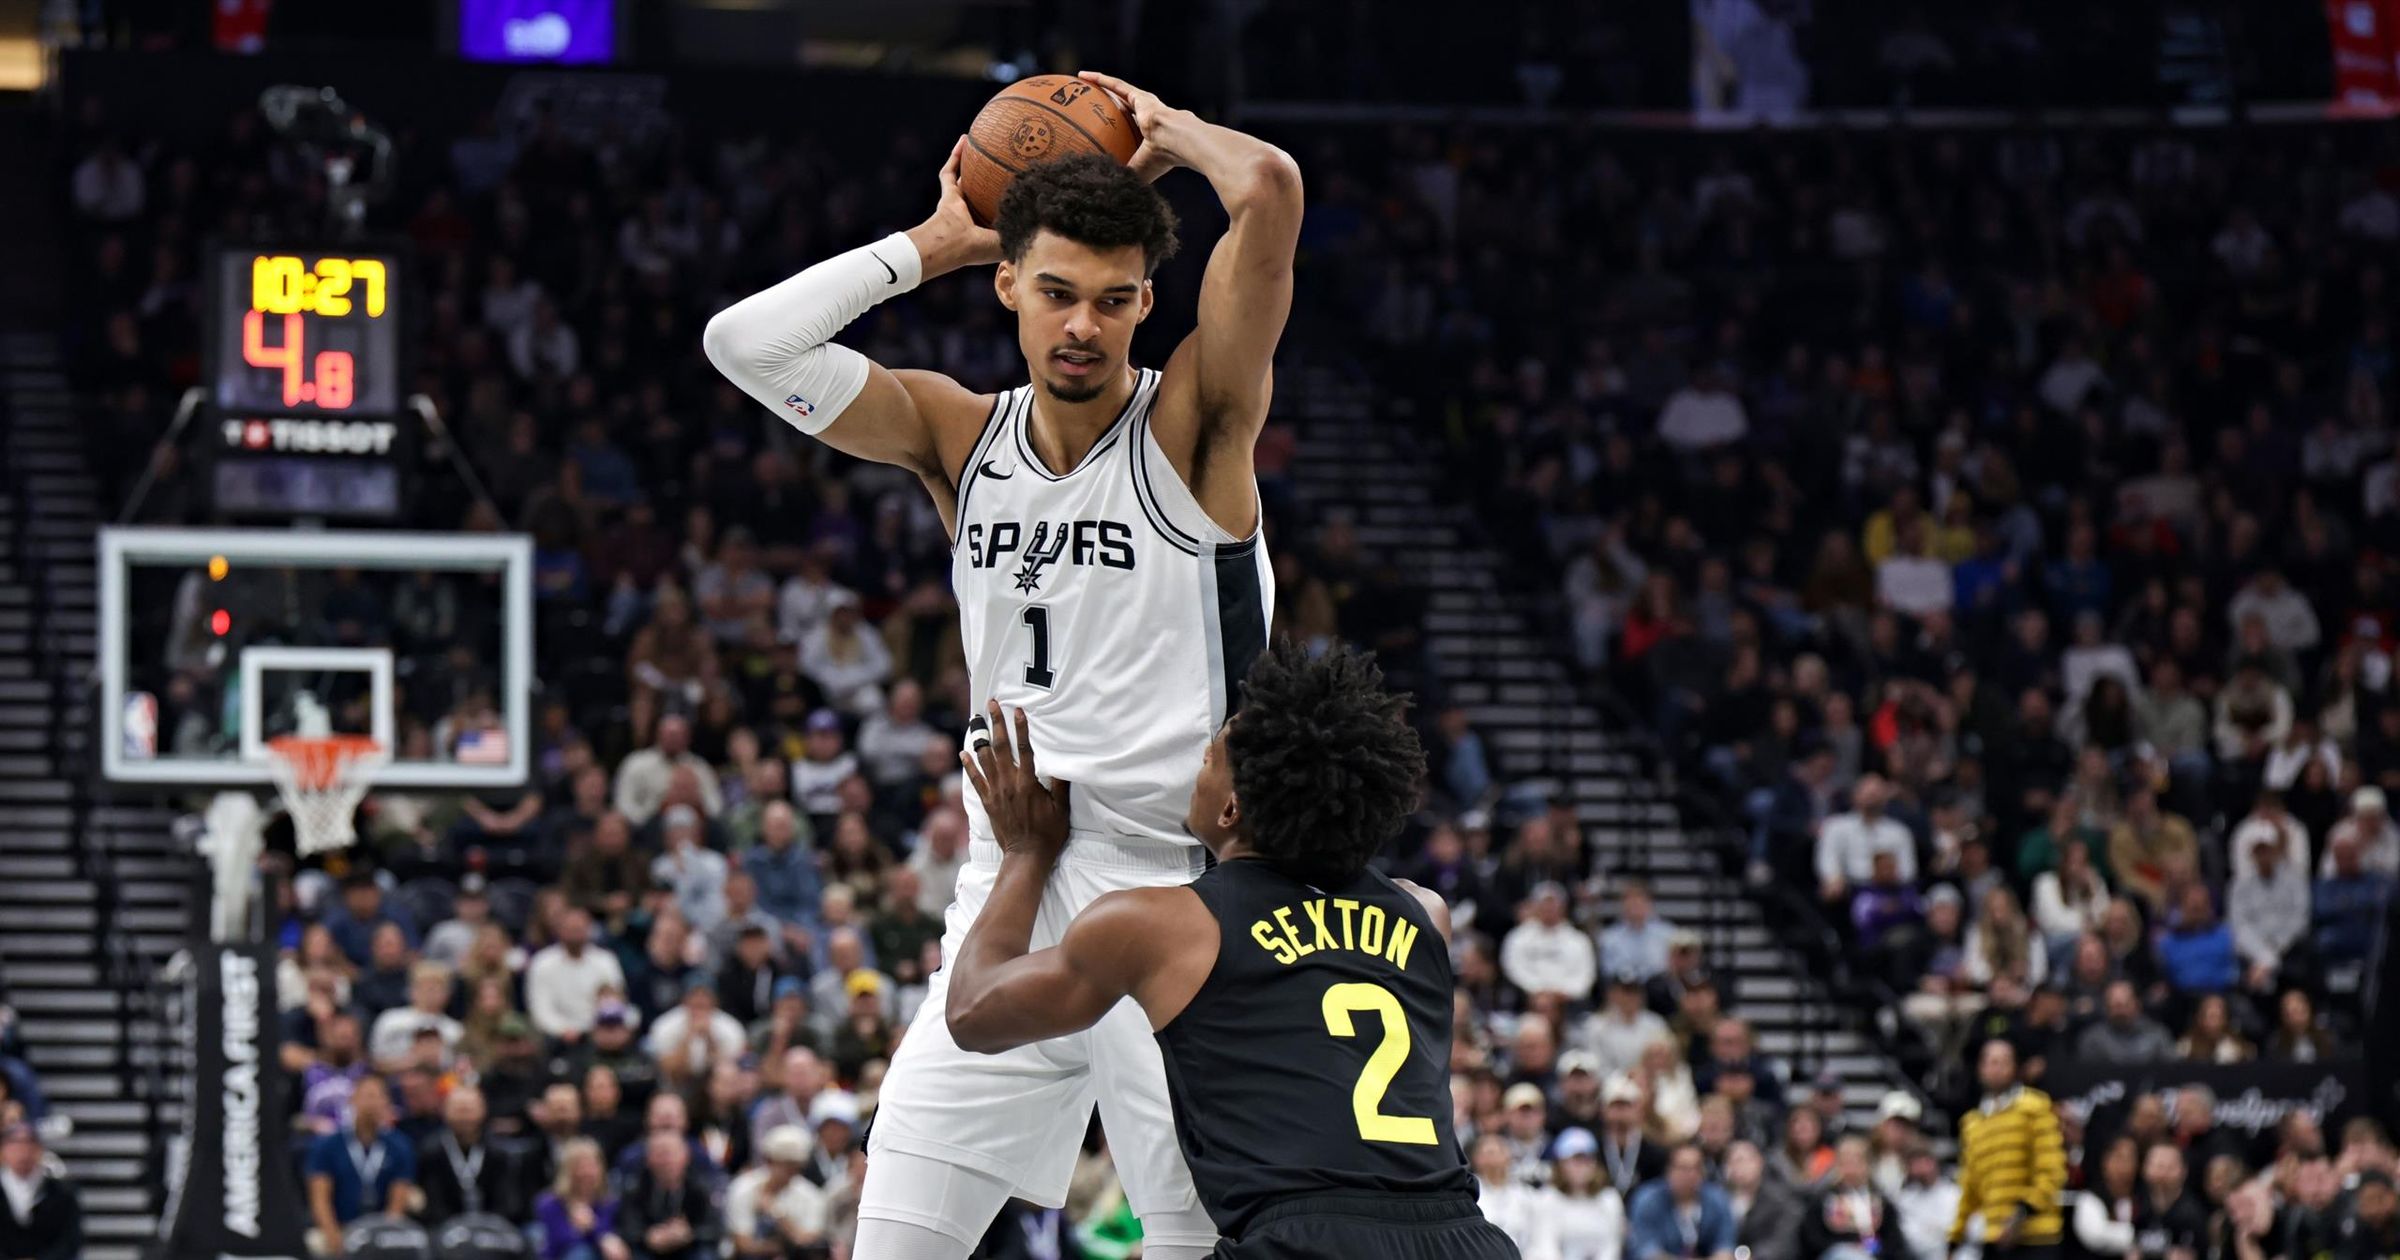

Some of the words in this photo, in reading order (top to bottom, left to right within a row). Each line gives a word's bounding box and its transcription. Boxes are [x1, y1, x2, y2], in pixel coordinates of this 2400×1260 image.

[252, 255, 386, 318] 10:27
[243, 308, 354, 409] 4.8
[968, 520, 1136, 596] SPURS
[1020, 603, 1057, 694] 1
[1250, 898, 1419, 971] SEXTON
[220, 949, 260, 1062] FIRST
[1322, 982, 1439, 1145] 2
[221, 1063, 261, 1238] AMERICA
